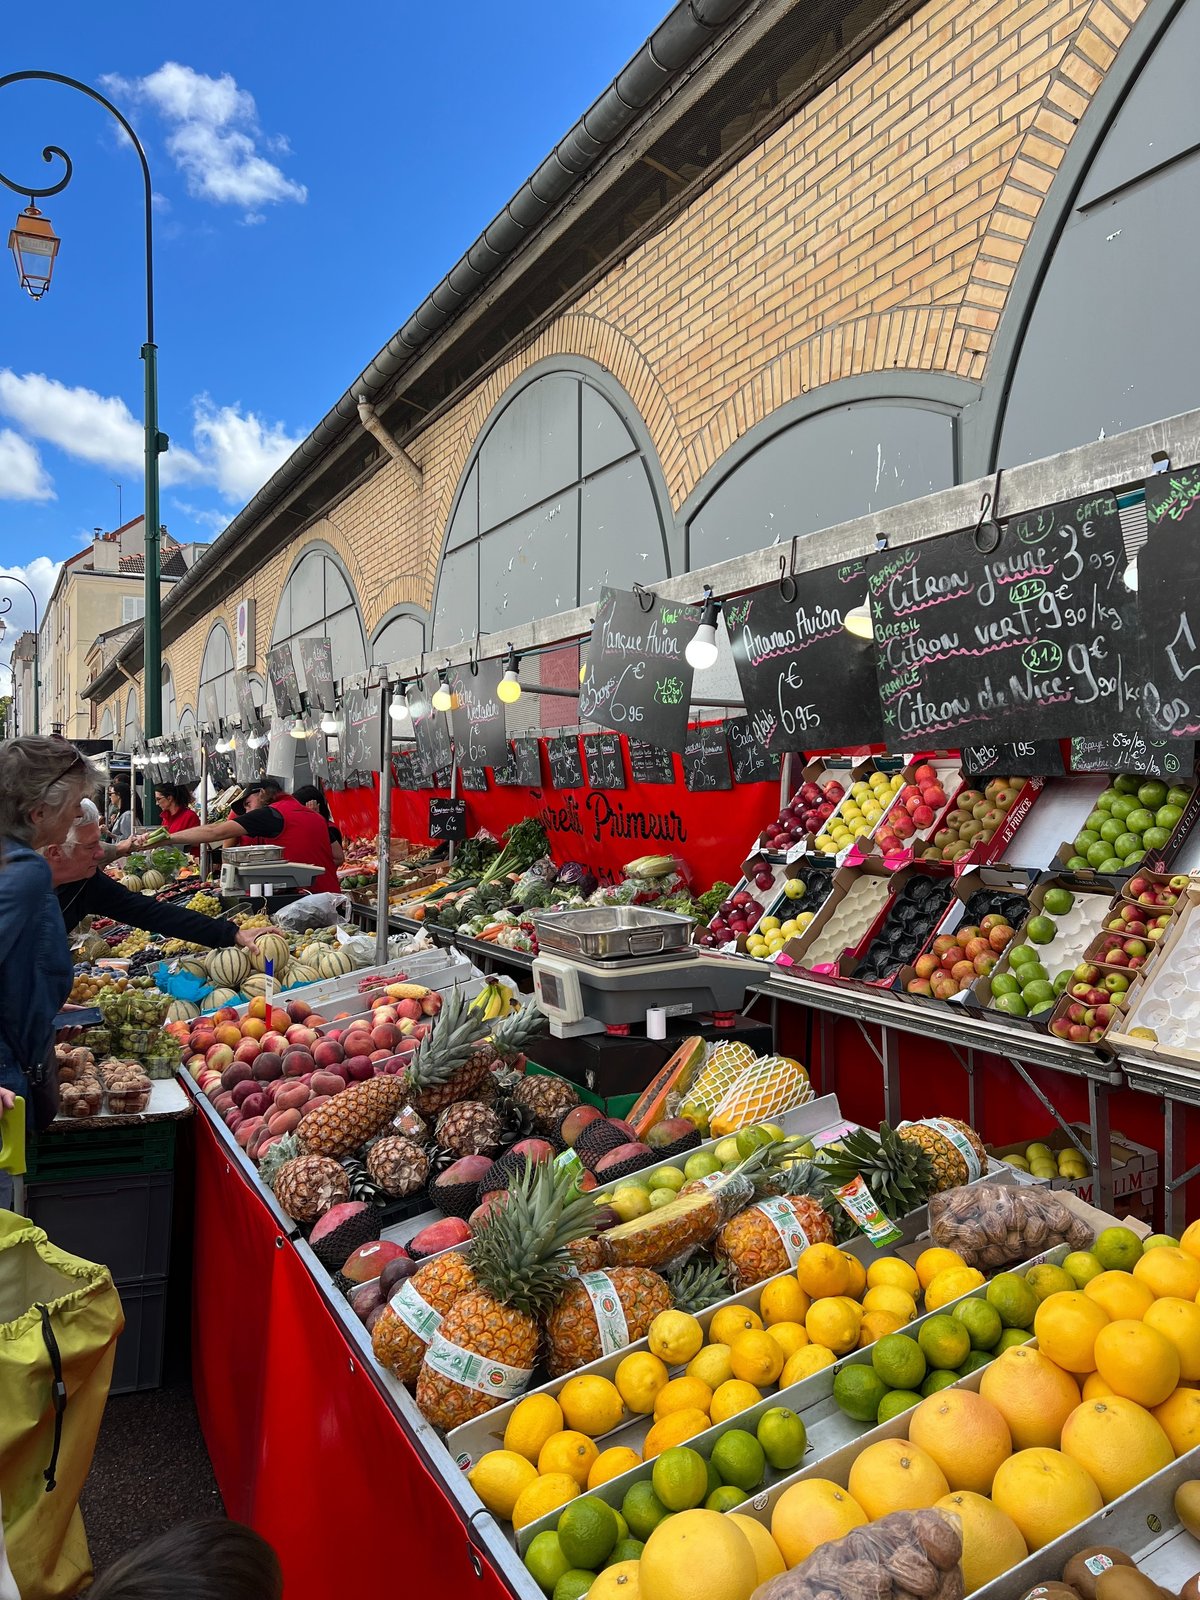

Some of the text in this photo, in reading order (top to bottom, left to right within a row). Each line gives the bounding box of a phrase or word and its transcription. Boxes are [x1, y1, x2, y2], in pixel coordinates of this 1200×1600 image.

[645, 620, 681, 655] Avion
[742, 606, 845, 661] Ananas Avion
[880, 666, 920, 700] FRANCE
[977, 676, 1009, 710] de
[585, 791, 688, 843] Primeur
[1002, 797, 1032, 843] LE PRINCE
